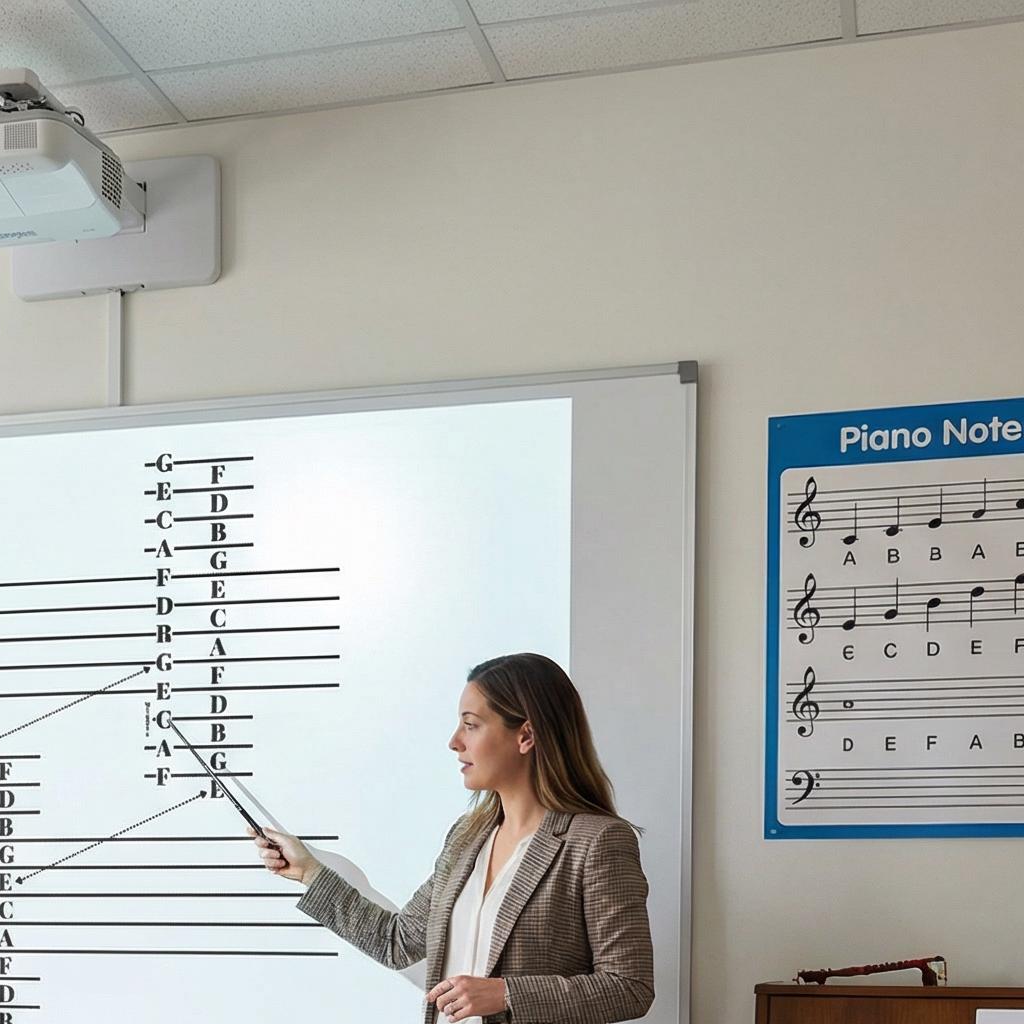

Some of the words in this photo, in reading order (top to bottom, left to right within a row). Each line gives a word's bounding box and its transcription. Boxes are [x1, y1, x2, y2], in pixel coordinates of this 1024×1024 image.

[839, 423, 932, 453] Piano
[154, 454, 172, 472] G
[211, 466, 225, 484] F
[156, 482, 171, 500] E
[210, 494, 228, 512] D
[154, 511, 172, 529] C
[210, 523, 226, 541] B
[155, 540, 172, 558] A
[843, 551, 856, 565] A
[888, 549, 899, 563] B
[930, 547, 941, 560] B
[972, 544, 985, 559] A
[209, 551, 227, 569] G
[156, 568, 170, 586] F
[210, 580, 225, 598] E
[156, 597, 173, 615] D
[209, 609, 225, 627] C
[209, 638, 226, 656] A
[884, 643, 897, 658] C
[927, 642, 940, 656] D
[971, 640, 982, 654] E
[154, 653, 171, 671] G
[210, 667, 224, 684] F
[156, 683, 170, 700] E
[210, 695, 227, 713] D
[156, 711, 172, 729] C
[210, 724, 225, 742] B
[156, 740, 171, 757] A
[843, 738, 853, 751] D
[886, 737, 896, 751] E
[927, 736, 937, 750] F
[970, 735, 982, 749] A
[209, 752, 226, 770] G
[156, 768, 170, 785] F
[0, 957, 12, 974] F
